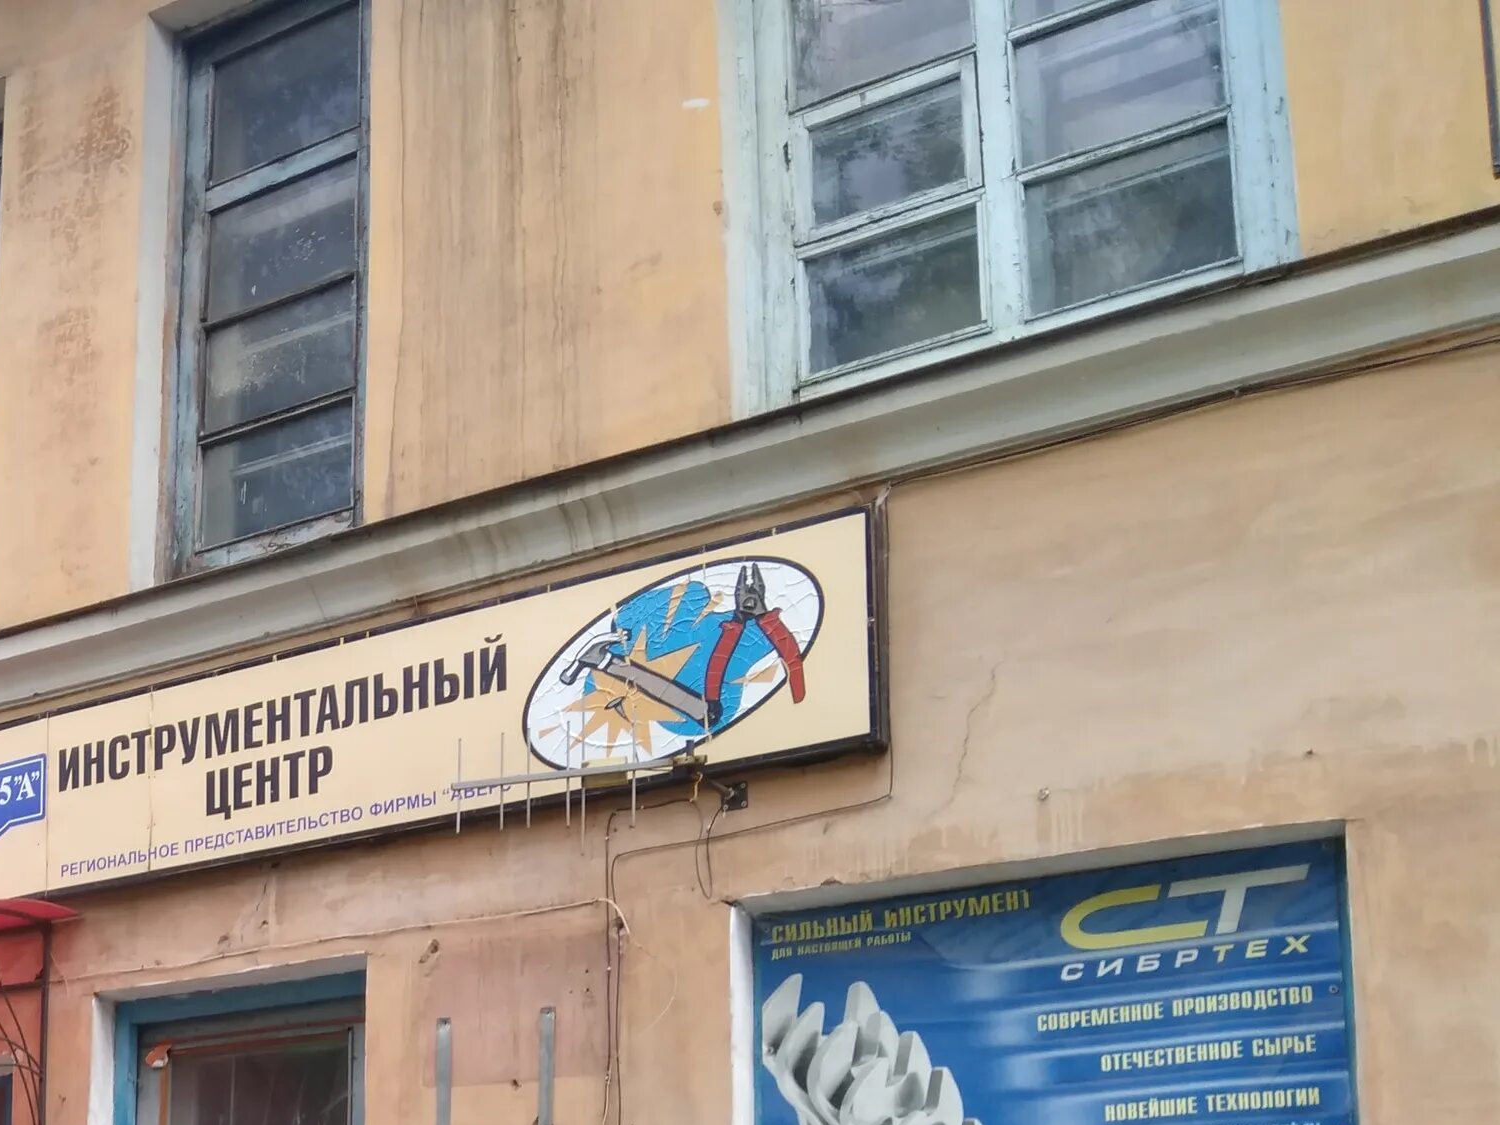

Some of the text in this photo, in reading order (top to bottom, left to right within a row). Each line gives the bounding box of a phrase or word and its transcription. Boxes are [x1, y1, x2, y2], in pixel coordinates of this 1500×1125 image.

[58, 634, 507, 792] ИНСТРУМЕНТАЛЬНЫЙ
[205, 746, 333, 820] ЦЕНТР
[60, 842, 179, 878] РЕГИОНАЛЬНОЕ
[184, 806, 363, 854] ПРЕДСТАВИТЕЛЬСТВО
[369, 790, 437, 818] ФИРМЫ
[771, 909, 874, 944] СИЛЬНЫЙ
[771, 946, 793, 961] ДЛЯ
[866, 931, 912, 947] РАБОТЫ
[1060, 934, 1312, 982] СИБРТЕХ
[1036, 985, 1314, 1033] СОВРЕМЕННОЕ ПРОИЗВОДСТВО
[1100, 1034, 1317, 1073] ОТЕЧЕСТВЕННОЕ СЫРЬЕ
[1104, 1087, 1320, 1122] НОВЕЙШИЕ ТЕХНОЛОГИИ
